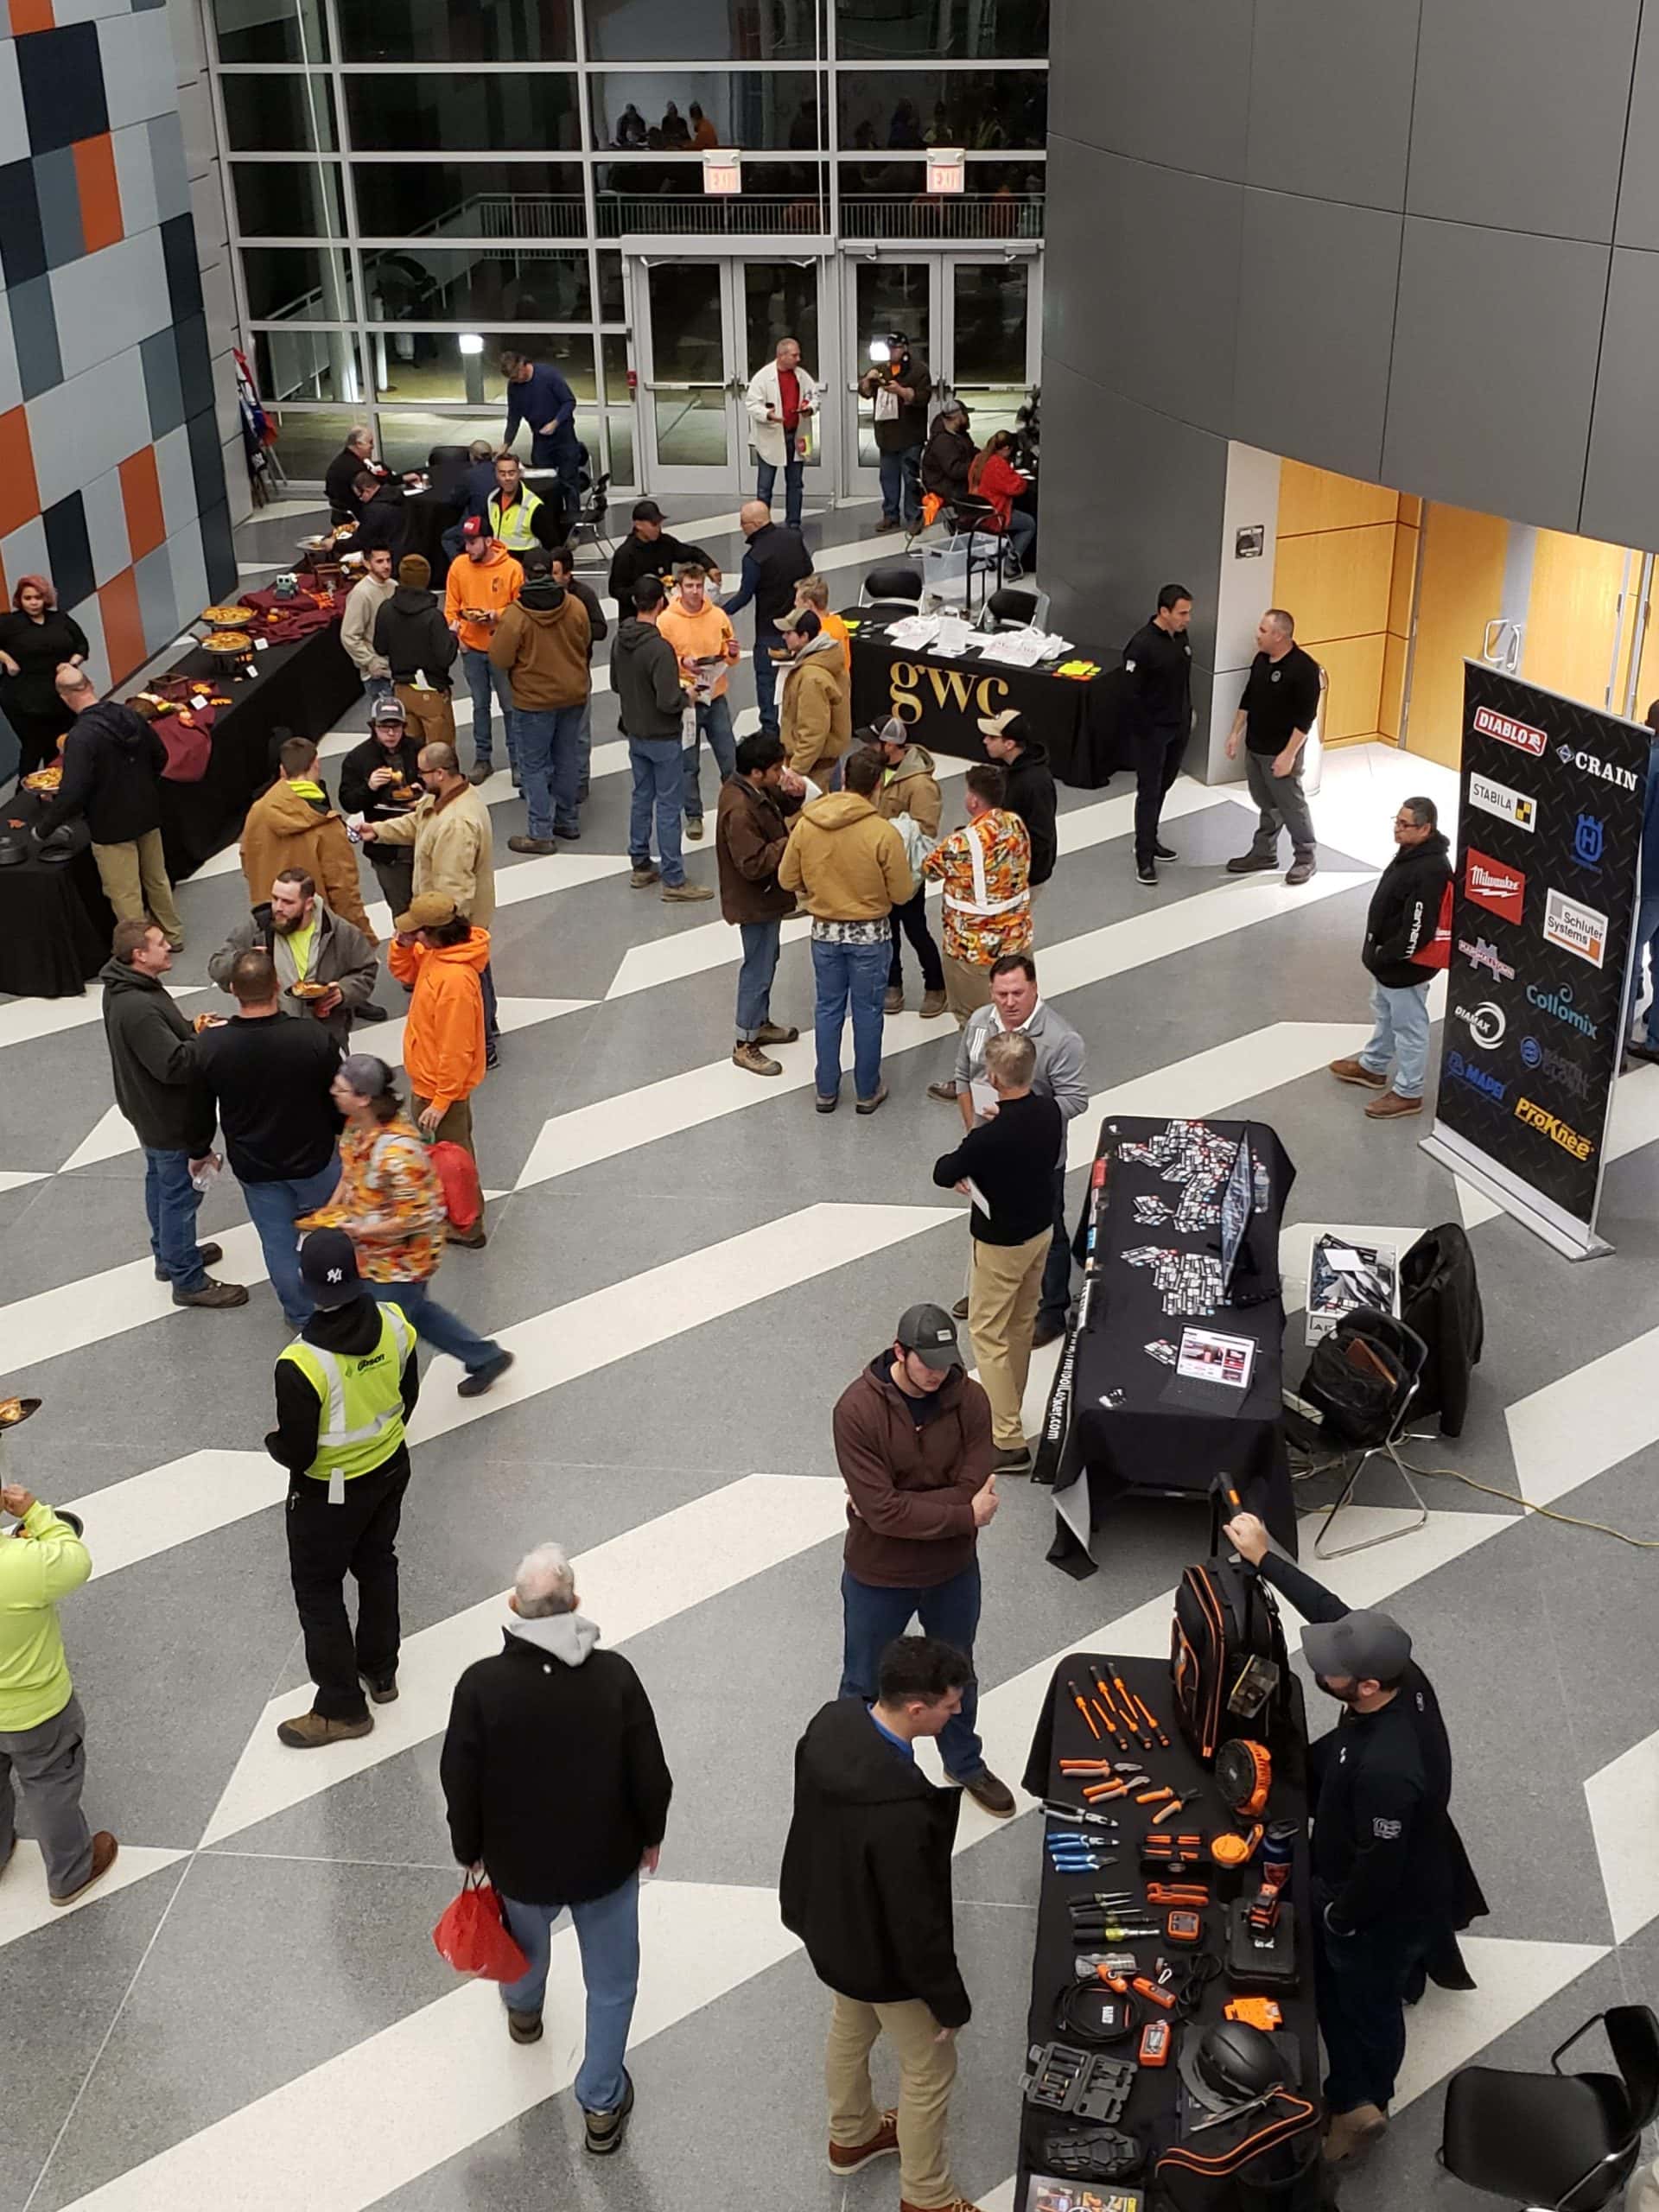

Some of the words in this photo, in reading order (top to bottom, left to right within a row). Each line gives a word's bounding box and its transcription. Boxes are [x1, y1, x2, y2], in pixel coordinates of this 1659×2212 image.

[933, 168, 959, 189] EXIT
[890, 661, 1009, 725] gwc
[1478, 710, 1528, 745] DIABLO
[1574, 752, 1638, 791] CRAIN
[1474, 783, 1512, 811] STABILA
[1548, 916, 1588, 945] Systems
[1454, 1005, 1491, 1034] DIAMAX
[1526, 983, 1597, 1040] Collomix
[1465, 1064, 1507, 1100] MAPEI
[1515, 1097, 1592, 1158] ProKnee
